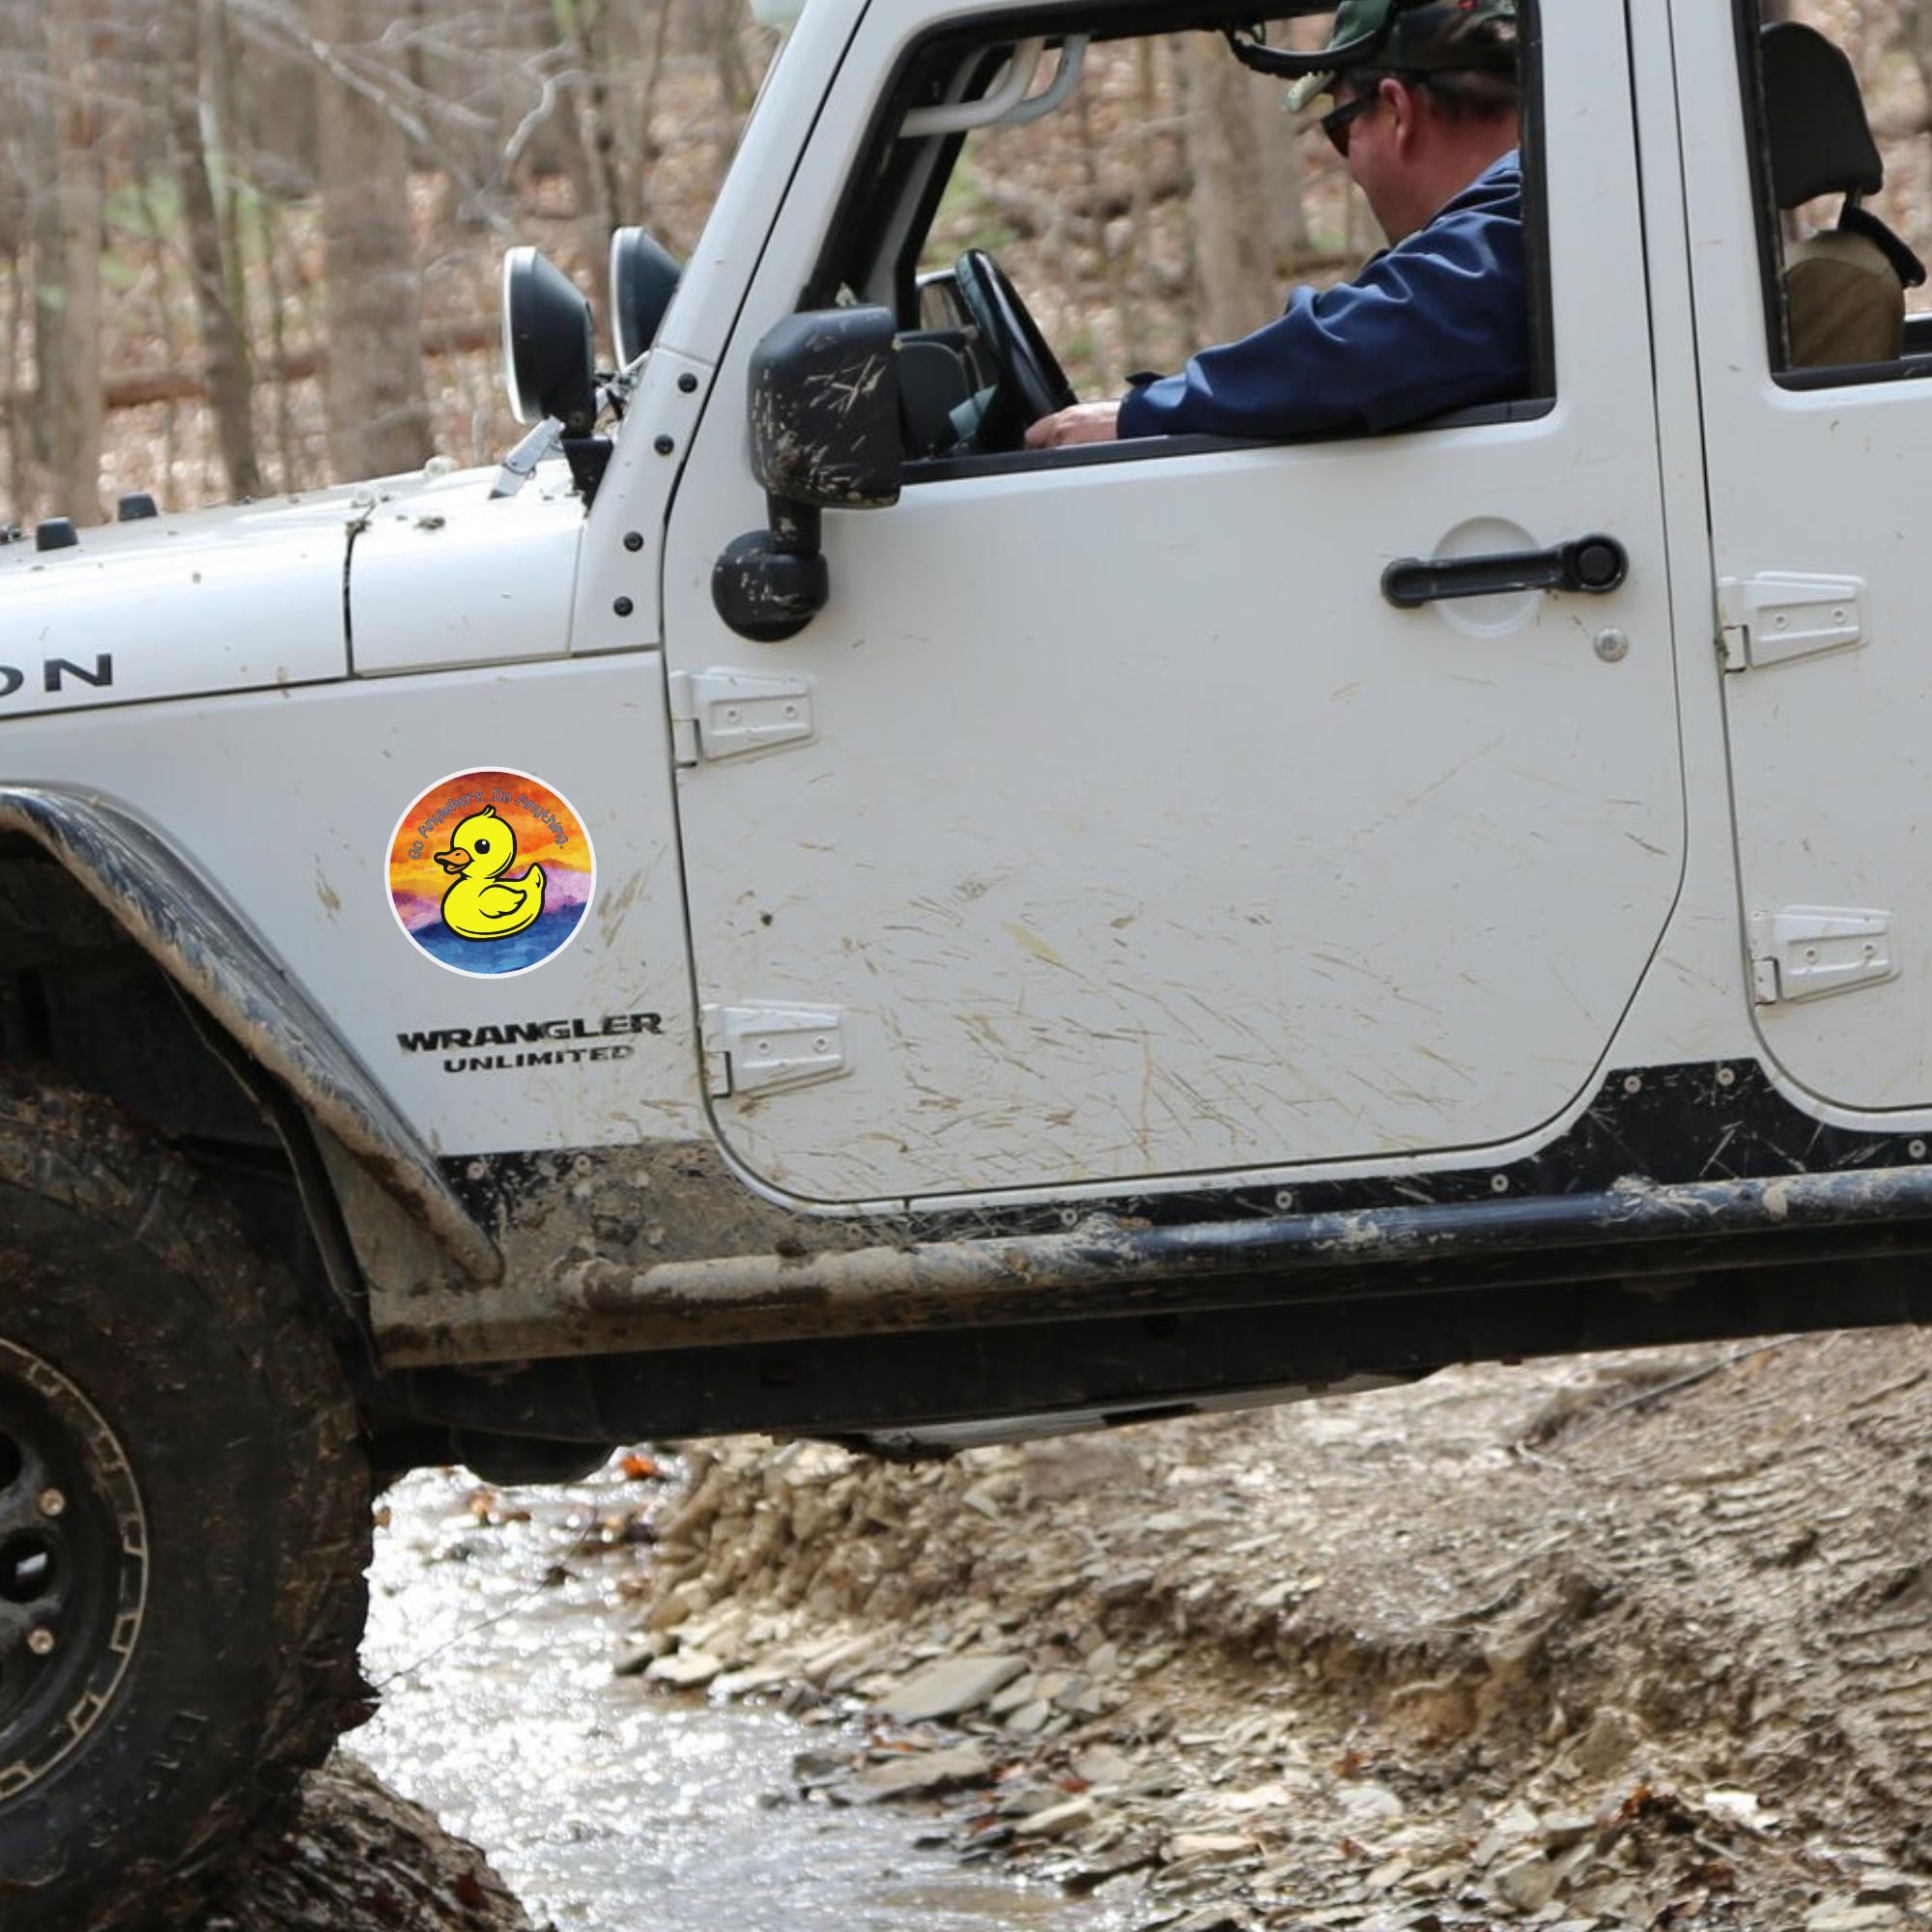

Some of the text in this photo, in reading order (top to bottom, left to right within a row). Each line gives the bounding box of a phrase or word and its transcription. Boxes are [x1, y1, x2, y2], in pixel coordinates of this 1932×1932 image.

[408, 787, 569, 860] Go Anywhere. Do Anything.
[396, 1011, 665, 1053] WRANGLER
[442, 1044, 635, 1073] UNLIMITED
